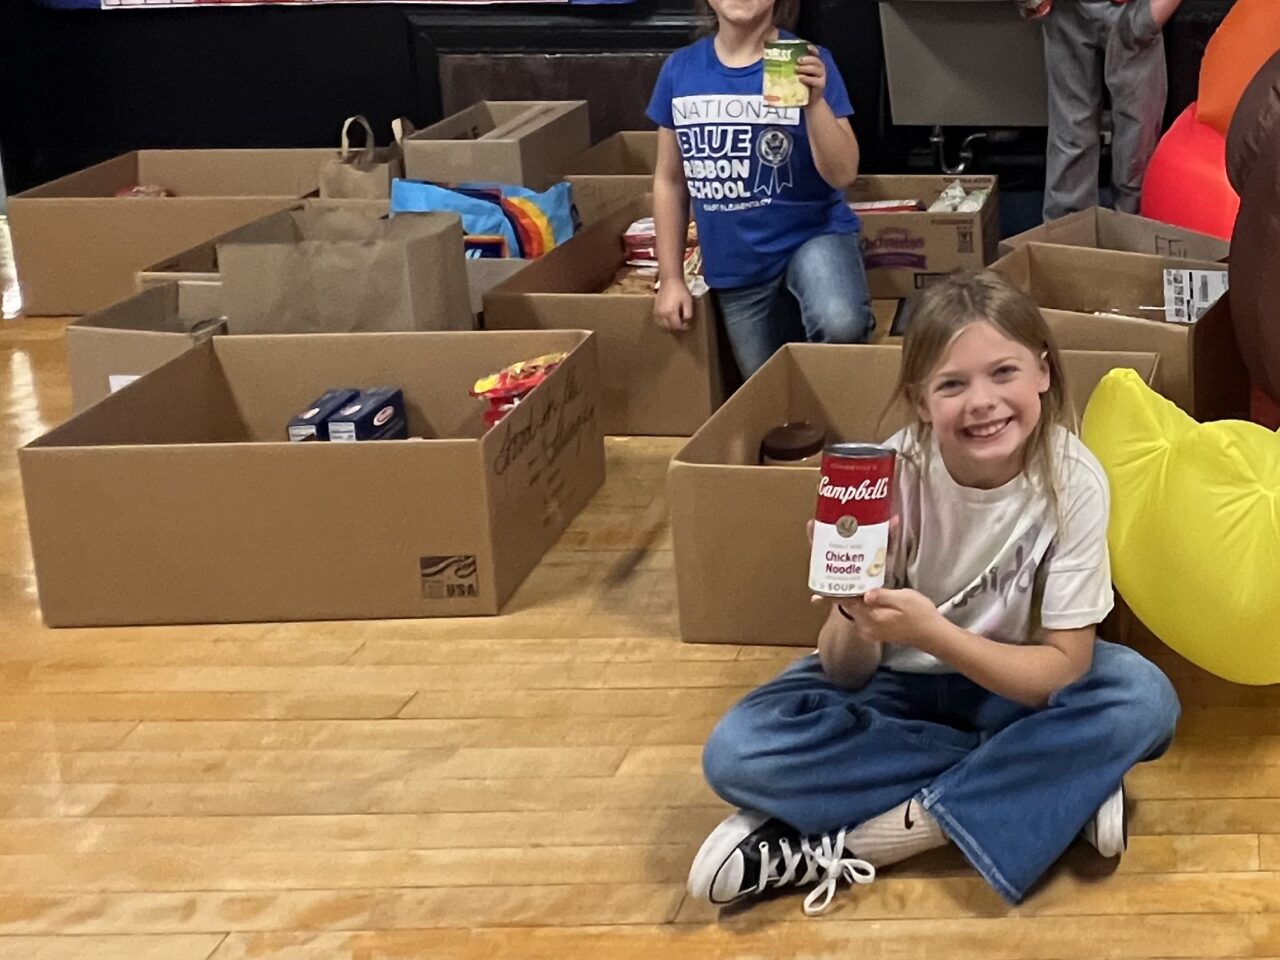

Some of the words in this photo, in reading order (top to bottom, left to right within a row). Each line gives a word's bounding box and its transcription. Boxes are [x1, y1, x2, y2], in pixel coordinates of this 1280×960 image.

[672, 98, 796, 121] NATIONAL
[676, 126, 752, 158] BLUE
[683, 158, 750, 179] RIBBON
[687, 181, 751, 200] SCHOOL
[825, 551, 865, 563] Chicken
[825, 563, 862, 575] Noodle
[446, 583, 476, 597] USA
[827, 583, 856, 592] SOUP
